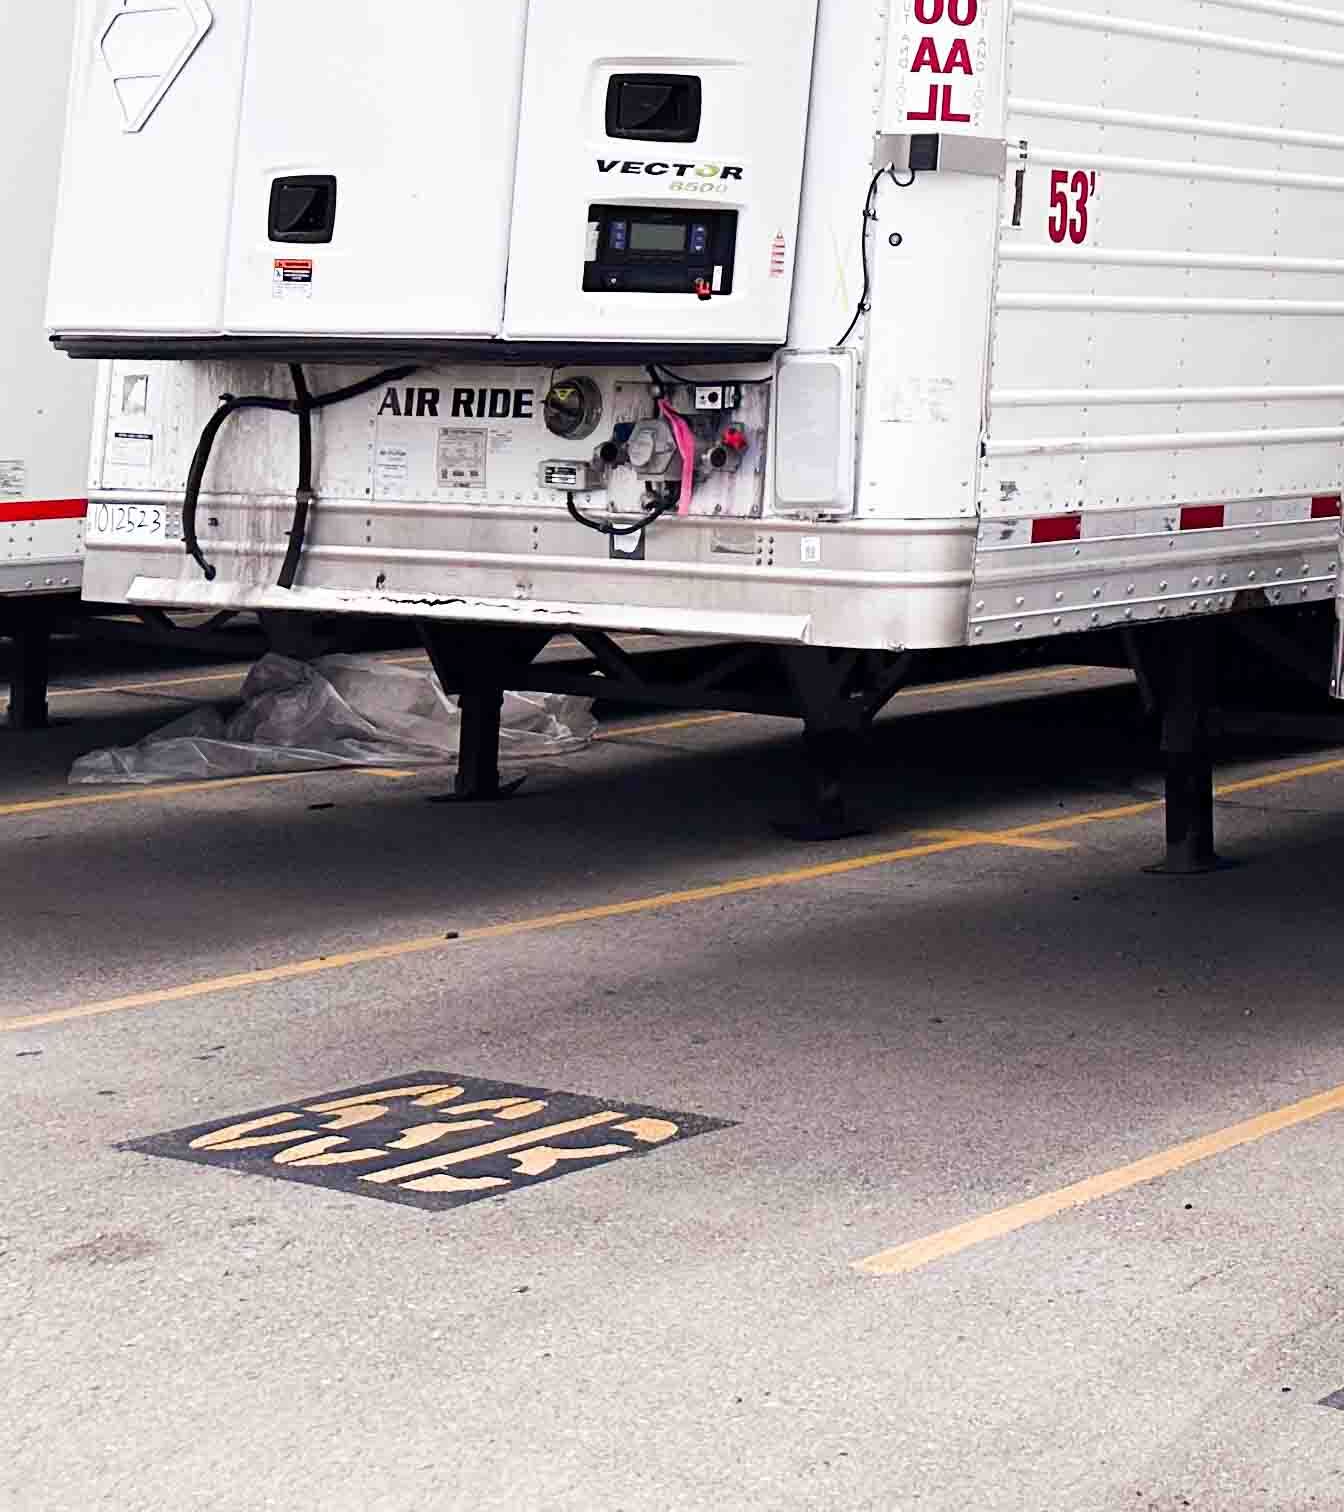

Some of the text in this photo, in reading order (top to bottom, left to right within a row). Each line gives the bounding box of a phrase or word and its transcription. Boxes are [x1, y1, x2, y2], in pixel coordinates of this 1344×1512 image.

[596, 159, 743, 180] VECTOR
[1048, 169, 1096, 244] 53'
[377, 387, 534, 418] AIR RIDE
[95, 503, 161, 533] 1012523
